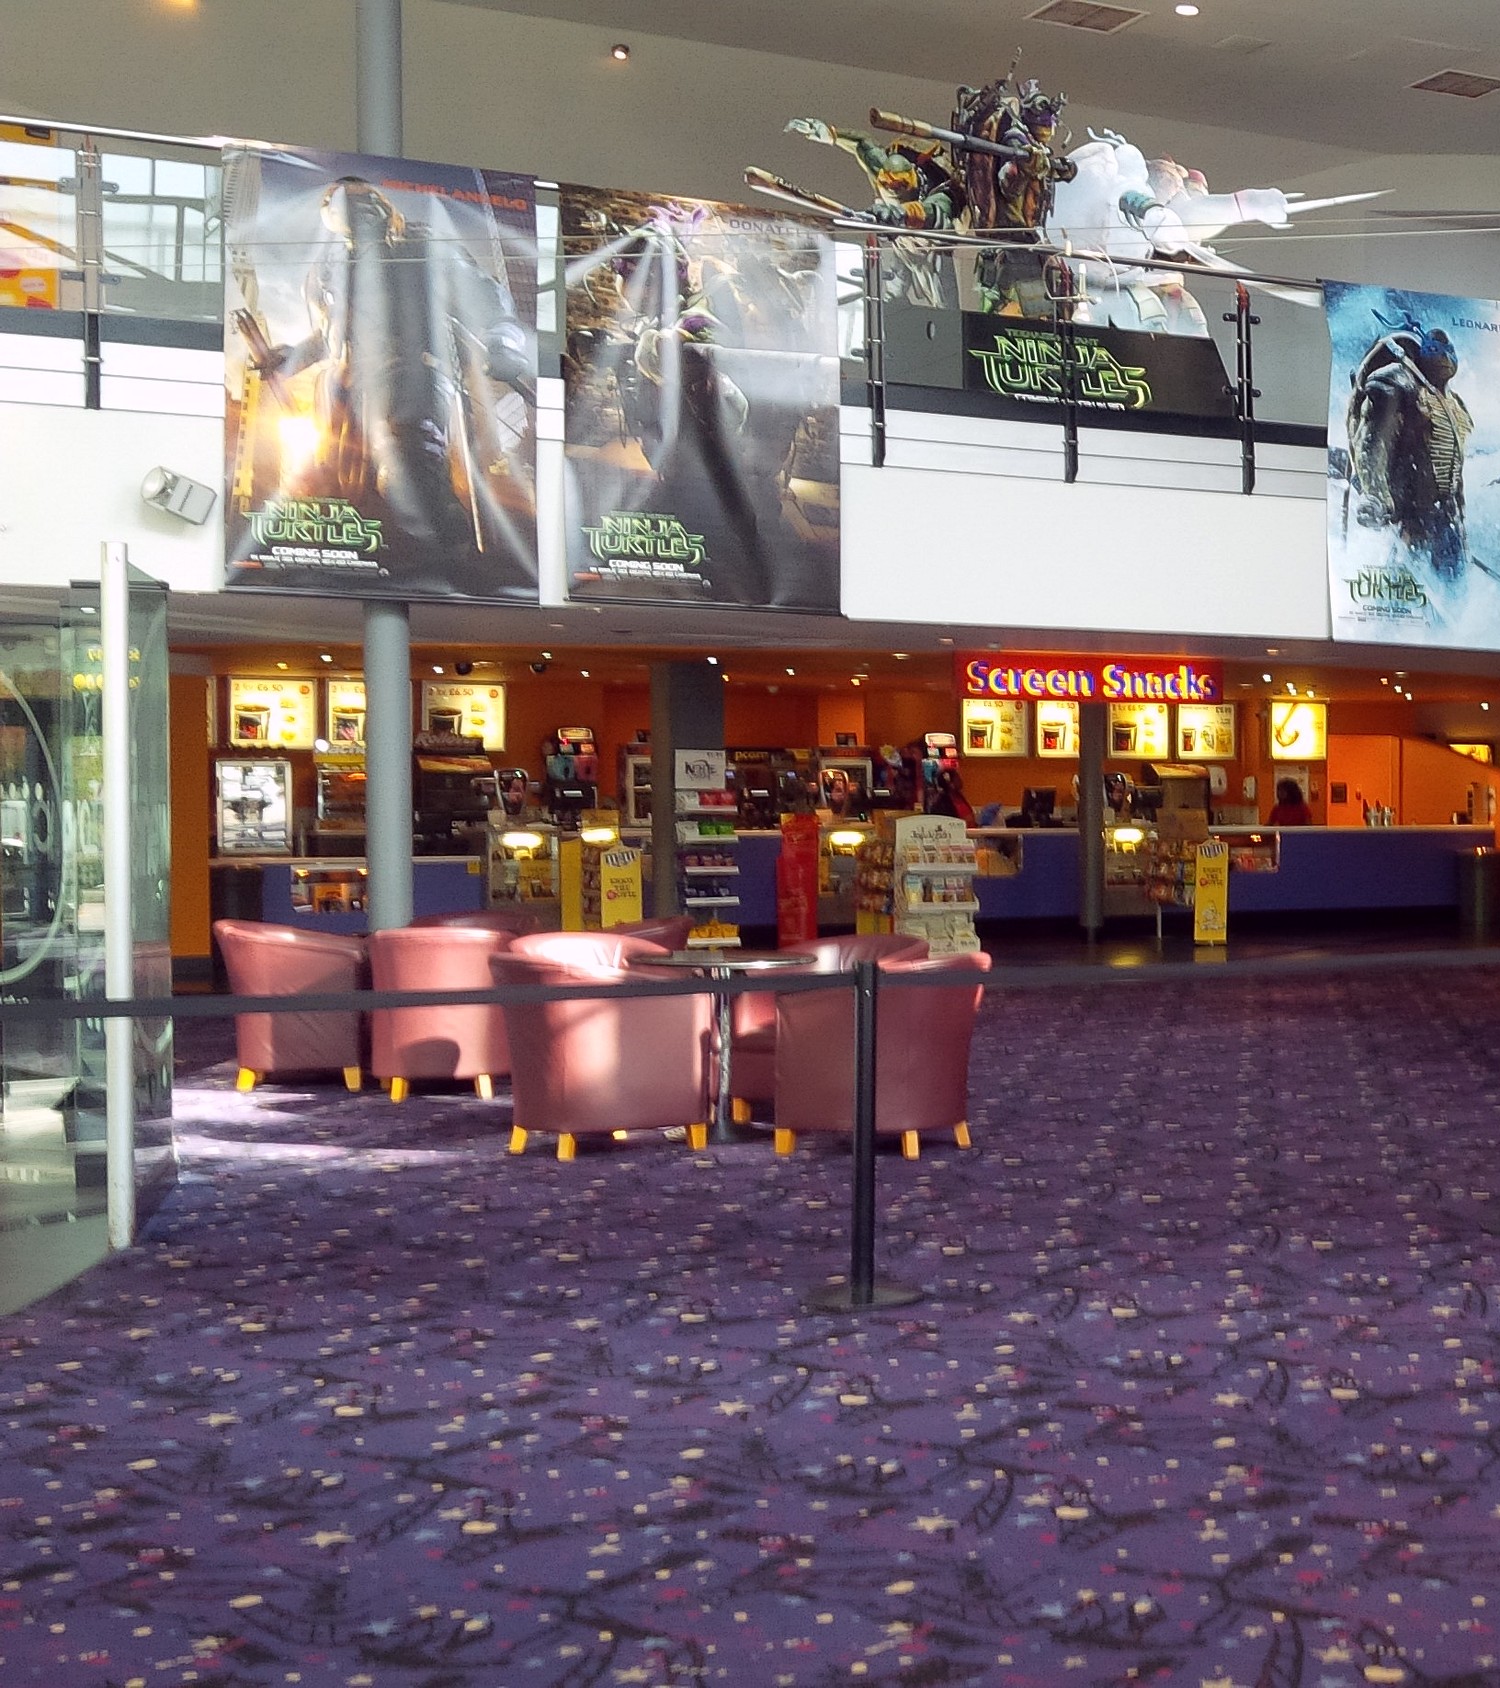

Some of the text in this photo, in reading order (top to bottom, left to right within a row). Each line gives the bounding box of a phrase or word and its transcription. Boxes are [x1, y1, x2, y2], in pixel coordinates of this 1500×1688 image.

[994, 335, 1117, 369] NINJA
[264, 499, 361, 523] NINJA
[240, 511, 384, 553] TURTLES
[601, 515, 687, 538] NINJA
[271, 546, 359, 560] COMING SOON
[581, 527, 707, 566] TURTLES
[609, 559, 685, 573] COMING SOON
[1357, 569, 1416, 585] NINJA
[1344, 579, 1427, 607] TURTLES
[1363, 604, 1412, 614] COMING SOON
[966, 660, 1217, 700] Screen Snacks
